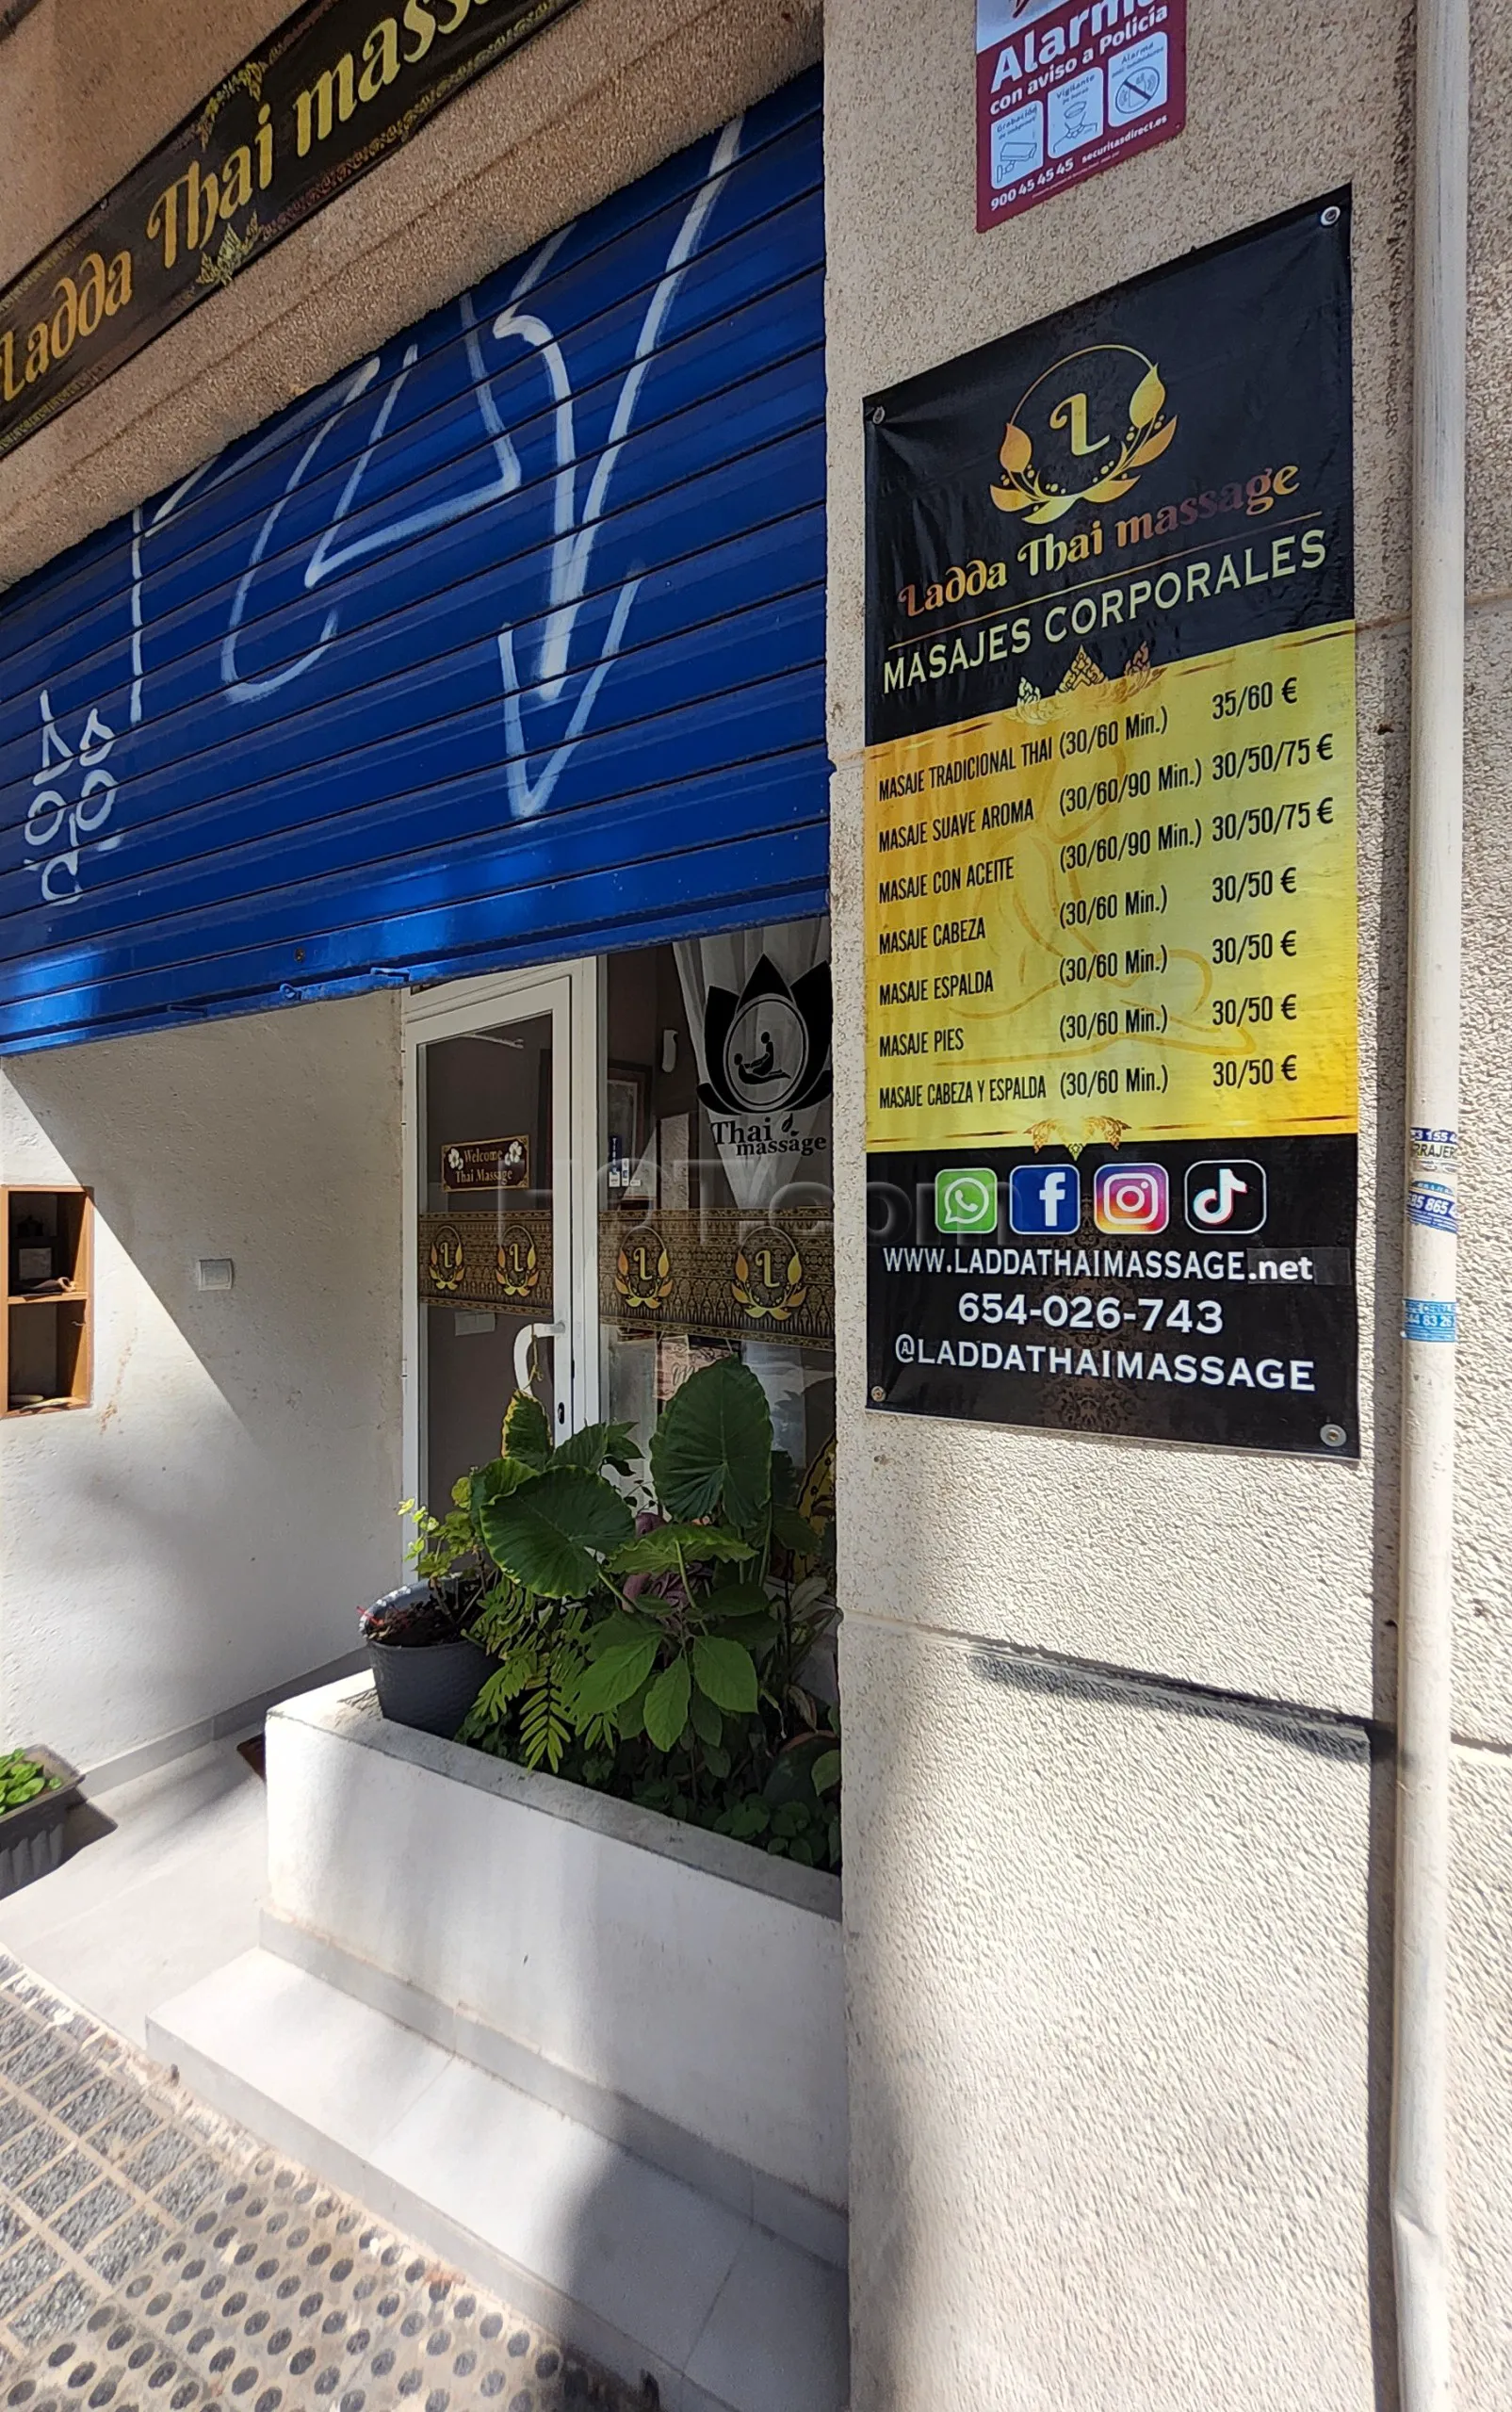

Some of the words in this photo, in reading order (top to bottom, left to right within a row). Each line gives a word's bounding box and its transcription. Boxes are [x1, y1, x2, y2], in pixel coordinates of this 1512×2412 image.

[990, 0, 1155, 93] Alarm
[990, 90, 1023, 115] con
[1028, 57, 1077, 94] aviso
[1082, 48, 1094, 64] a
[1099, 6, 1168, 55] Policía
[990, 190, 1016, 211] 900
[1017, 179, 1035, 196] 45
[1036, 168, 1054, 187] 45
[1056, 157, 1074, 176] 45
[1081, 115, 1168, 163] securitasdirect.es
[0, 250, 132, 401] Ladda
[146, 105, 274, 269] Thai
[293, 0, 488, 157] mas
[898, 560, 1008, 617] Ladda
[1016, 521, 1104, 577] Thai
[1114, 464, 1301, 548] massage
[883, 619, 1032, 693] MASAJES
[1044, 529, 1326, 644] CORPORALES
[879, 771, 925, 803] MASAJE
[929, 747, 1016, 790] TRADICIONAL
[1020, 738, 1052, 768] THAI
[1059, 720, 1118, 759] (30/60
[1125, 706, 1168, 740] Min.)
[1211, 681, 1273, 721] 35/60
[1282, 677, 1297, 705] €
[879, 823, 927, 853] MASAJE
[933, 809, 977, 842] SUAVE
[981, 797, 1034, 831] AROMA
[1059, 771, 1151, 817] (30/60/90
[1158, 758, 1202, 792] Min.)
[1211, 740, 1310, 782] 30/50/75
[1316, 733, 1333, 761] €
[879, 874, 927, 904] MASAJE
[933, 868, 961, 894] CON
[967, 856, 1014, 887] ACEITE
[1059, 830, 1151, 873] (30/60/90
[1158, 818, 1202, 851] Min.)
[1211, 803, 1310, 843] 30/50/75
[1317, 796, 1334, 825] €
[879, 927, 928, 954] MASAJE
[933, 917, 985, 948] CABEZA
[1059, 893, 1118, 929] (30/60
[1125, 885, 1168, 914] Min.)
[1211, 871, 1273, 904] 30/50
[1280, 866, 1297, 894] €
[879, 979, 928, 1007] MASAJE
[934, 970, 994, 1001] ESPALDA
[1059, 952, 1118, 987] (30/60
[1125, 944, 1168, 974] Min.)
[1211, 933, 1273, 966] 30/50
[1280, 930, 1297, 957] €
[879, 1032, 928, 1058] MASAJE
[934, 1027, 964, 1053] PIES
[1059, 1012, 1118, 1043] (30/60
[1125, 1004, 1168, 1034] Min.)
[1211, 997, 1273, 1027] 30/50
[1280, 994, 1297, 1020] €
[880, 1084, 923, 1109] MASAJE
[927, 1081, 973, 1106] CABEZA
[978, 1080, 984, 1101] Y
[990, 1075, 1047, 1101] ESPALDA
[1059, 1070, 1119, 1100] (30/60
[1125, 1066, 1168, 1093] Min.)
[1212, 1058, 1274, 1088] 30/50
[1280, 1054, 1298, 1082] €
[463, 1149, 503, 1163] Welcome
[710, 1117, 772, 1145] Thai
[737, 1136, 827, 1156] massage
[1425, 1132, 1448, 1142] 155
[456, 1169, 473, 1182] Thai
[476, 1169, 512, 1185] Massage
[1424, 1198, 1450, 1214] 865
[883, 1246, 1313, 1282] WWW.LADDATHAIMASSAGE.net
[958, 1292, 1224, 1335] 654-026-743
[894, 1333, 1317, 1393] @LADDATHAIMASSAGE
